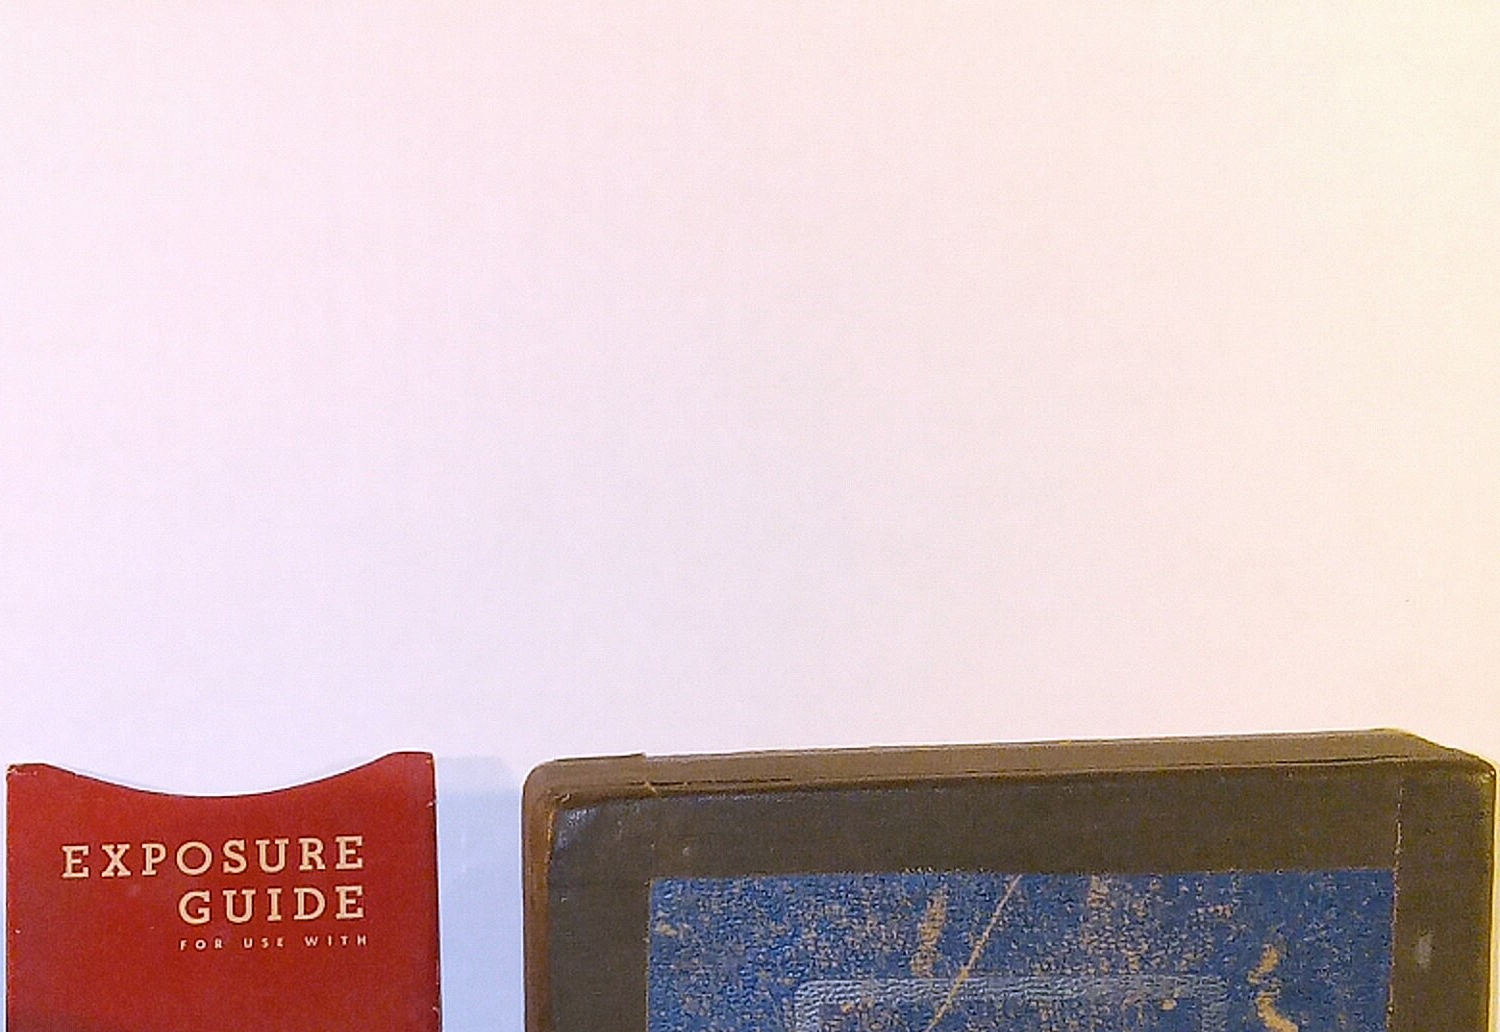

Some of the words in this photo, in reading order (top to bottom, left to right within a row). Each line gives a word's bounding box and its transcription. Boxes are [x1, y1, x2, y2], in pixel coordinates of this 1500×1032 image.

[61, 835, 364, 879] EXPOSURE
[178, 885, 364, 925] GUIDE
[180, 938, 223, 951] FOR
[243, 937, 284, 949] USE
[304, 935, 368, 947] WITH
